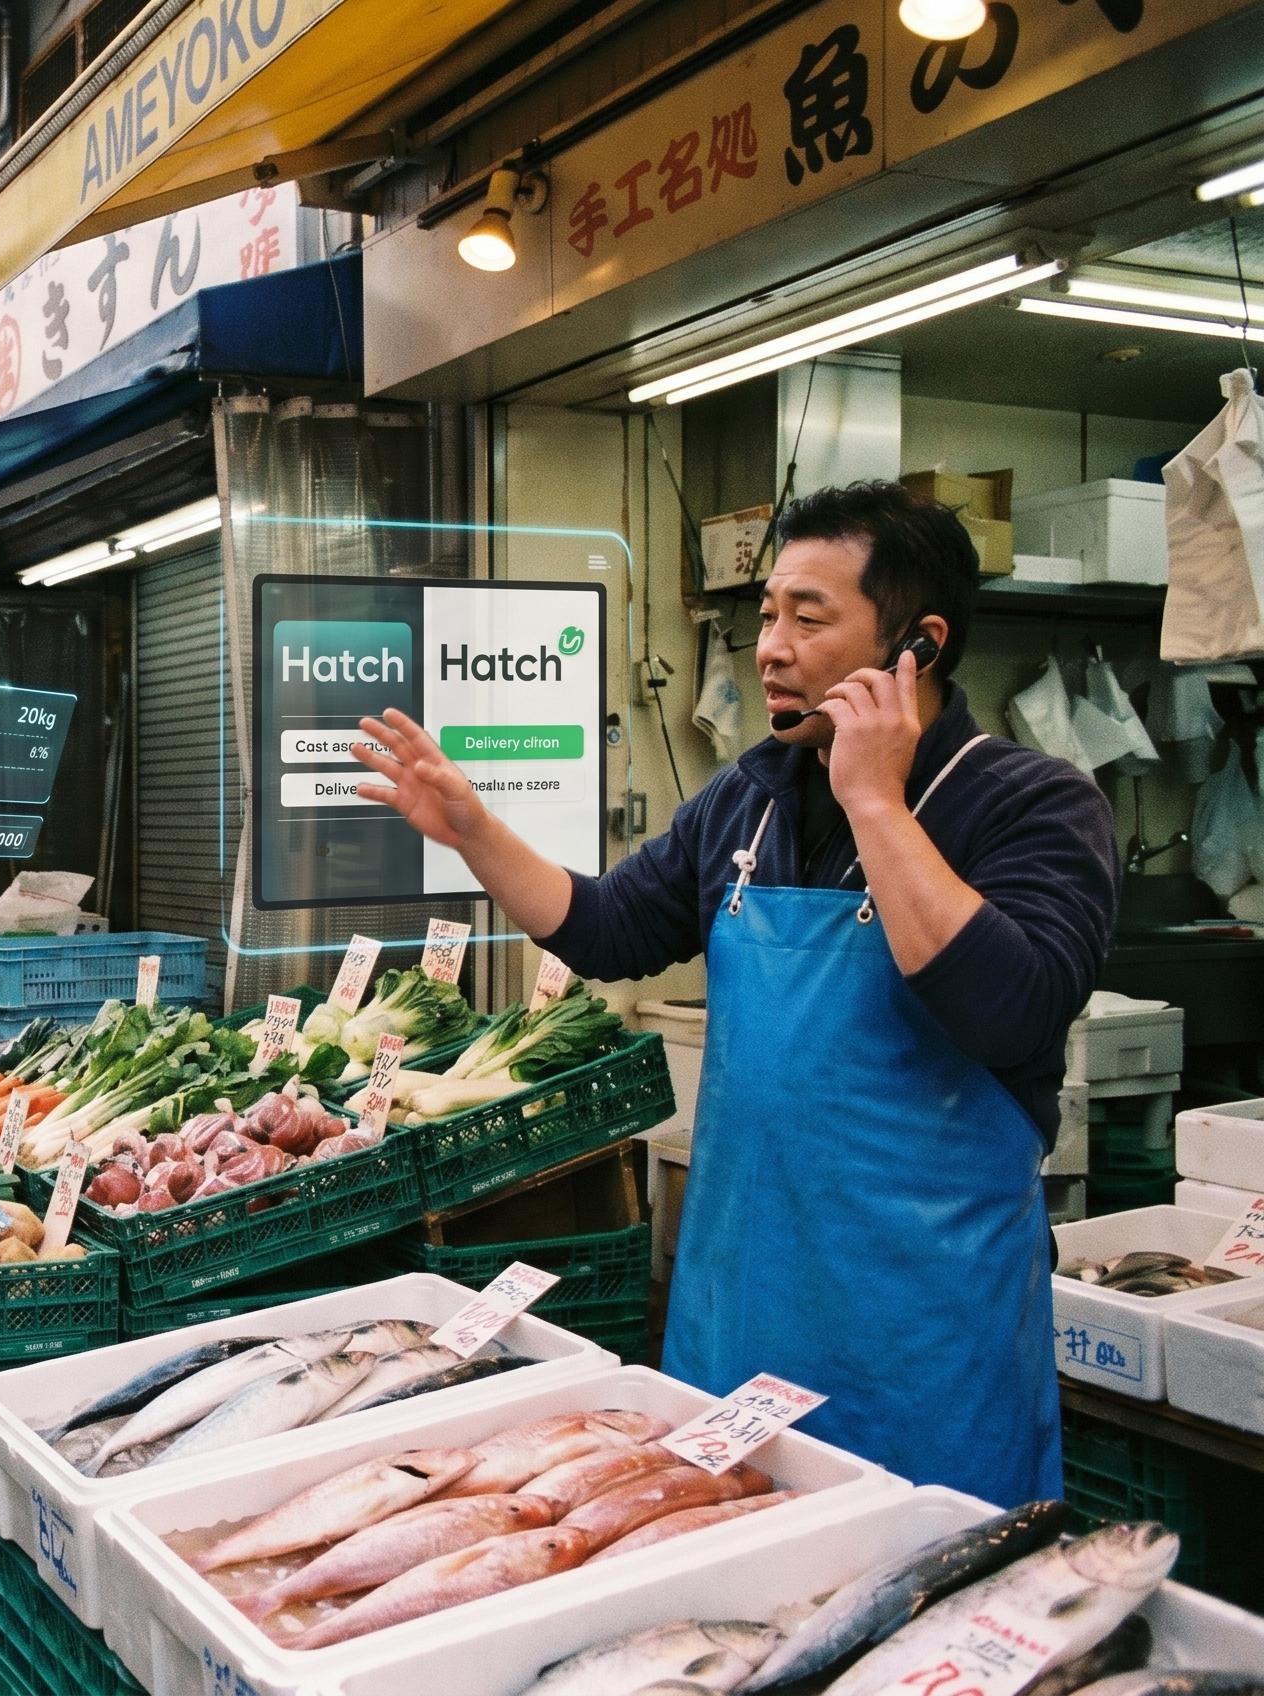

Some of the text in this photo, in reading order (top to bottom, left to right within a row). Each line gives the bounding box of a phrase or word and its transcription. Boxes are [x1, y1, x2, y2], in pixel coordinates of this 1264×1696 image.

[281, 645, 405, 683] Hatch
[439, 643, 563, 682] Hatch
[17, 706, 57, 731] 20kg
[295, 740, 329, 752] Cast
[465, 736, 520, 752] Delivery
[315, 783, 357, 796] Delive
